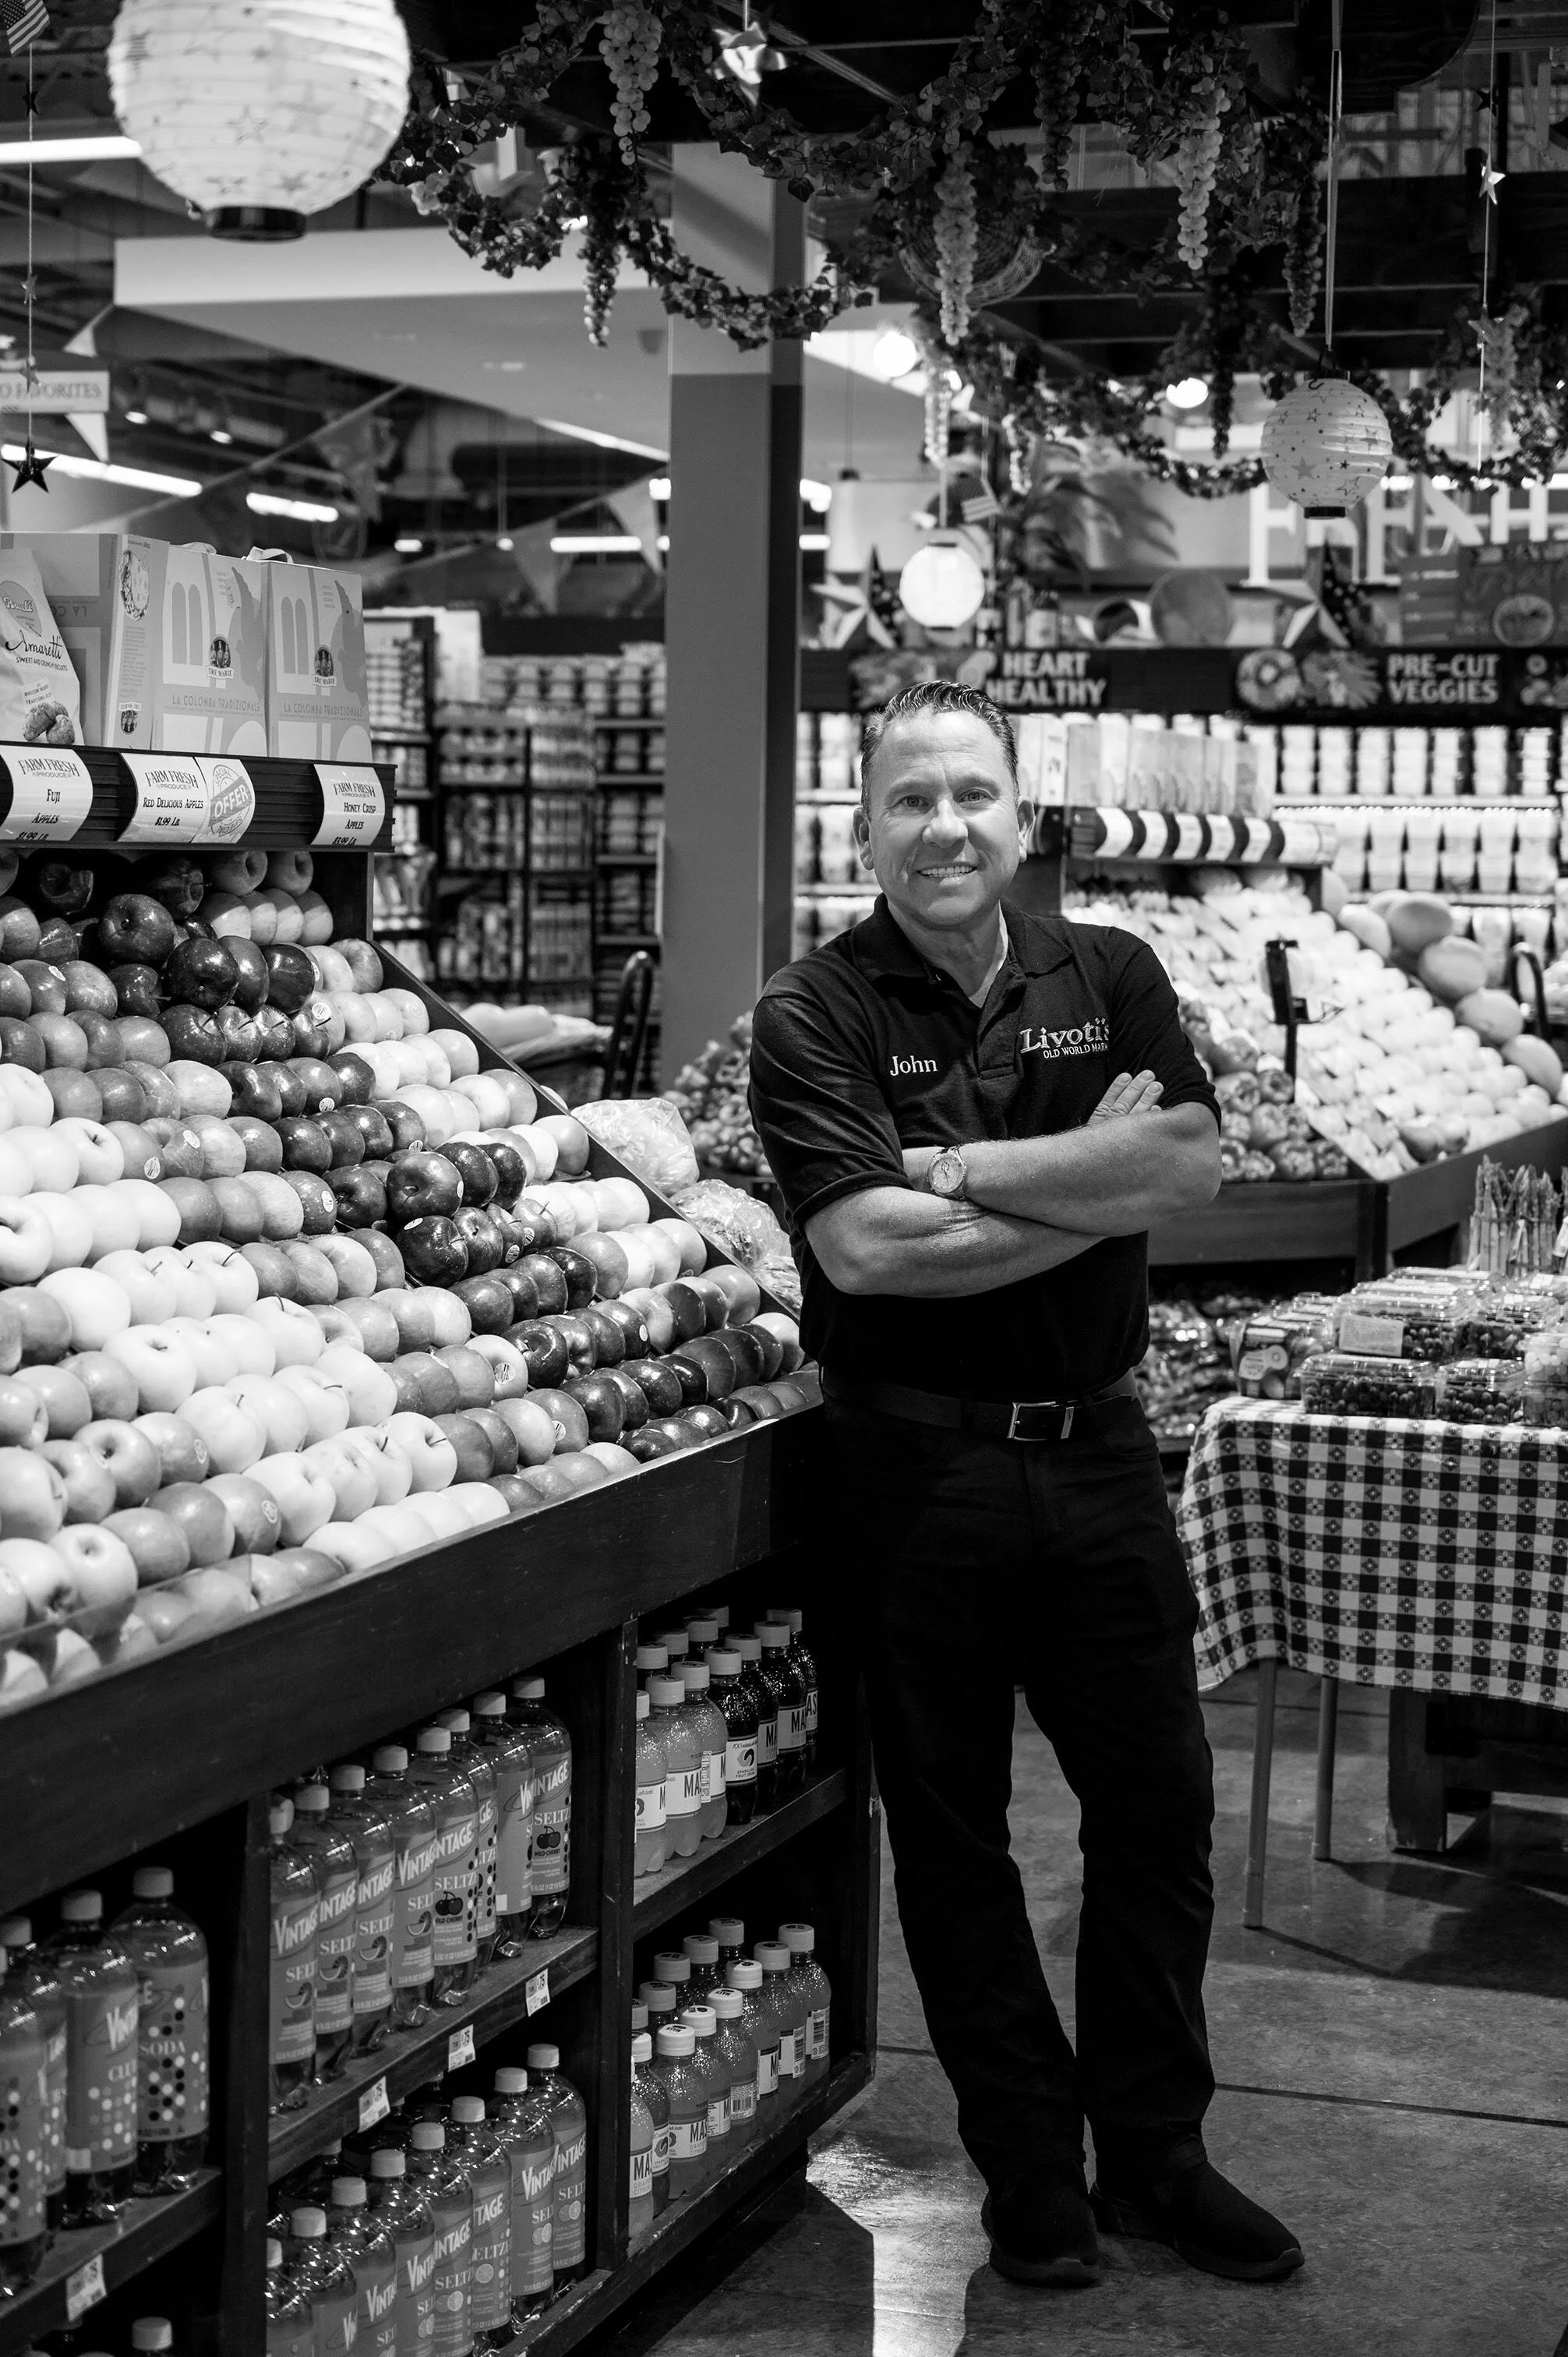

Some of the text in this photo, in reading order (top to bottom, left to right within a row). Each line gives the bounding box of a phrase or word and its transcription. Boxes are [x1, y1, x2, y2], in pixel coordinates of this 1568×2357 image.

[5, 630, 63, 659] Amaretti
[217, 668, 232, 677] MARIE
[1003, 652, 1089, 677] HEART
[1387, 653, 1500, 679] PRE-CUT
[172, 694, 182, 705] LA
[183, 695, 216, 708] COLOMBA
[218, 698, 261, 712] TRADIZIONALE
[986, 677, 1107, 706] HEALTHY
[1388, 679, 1499, 704] VEGGIES
[284, 702, 363, 718] LA COLOMBA TRADIZIONALE
[18, 758, 80, 777] FARM FRESH
[144, 770, 200, 789] FARM FRESH
[214, 784, 249, 818] OFFER
[333, 782, 376, 798] FARM FRESH
[155, 816, 171, 826] $1.99
[1043, 1048, 1061, 1059] OLD
[1061, 1044, 1090, 1056] WORLD
[889, 1055, 938, 1076] John
[436, 1821, 472, 1860] NTAGE
[358, 1861, 394, 1904] INTAGE
[320, 1879, 356, 1923] INTAGE
[475, 2193, 503, 2227] TAGE
[434, 2217, 471, 2260] INTAGE
